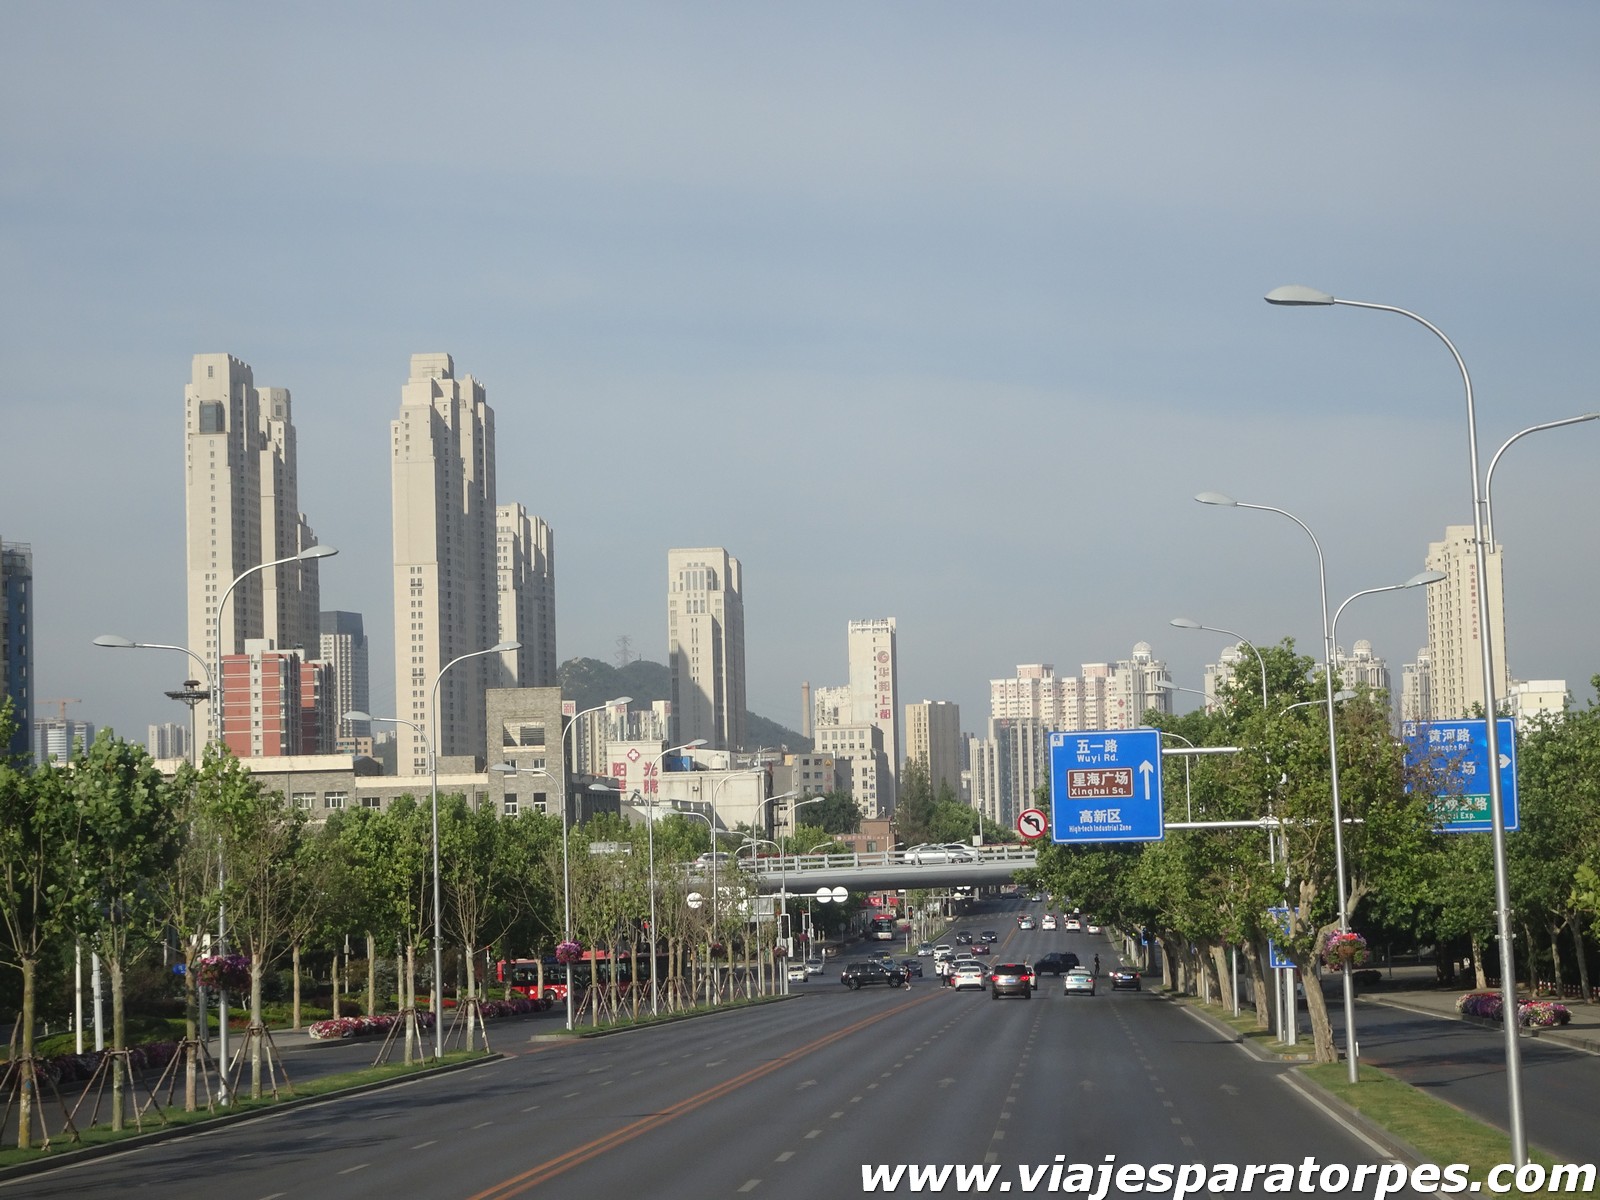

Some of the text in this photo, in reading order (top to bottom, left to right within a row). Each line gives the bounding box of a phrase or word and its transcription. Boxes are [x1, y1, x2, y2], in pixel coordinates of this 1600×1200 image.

[1428, 728, 1470, 743] 黄河路
[1077, 739, 1118, 754] 五一路
[1077, 753, 1118, 763] Wuyi Rd.
[613, 762, 658, 776] 阳光
[1073, 771, 1128, 787] 星海广场
[1071, 787, 1126, 796] Xinghai Sq.
[1079, 809, 1122, 824] 高新区
[1460, 812, 1476, 820] Exp.
[1069, 825, 1093, 833] High-tech
[1093, 824, 1118, 832] Industrial
